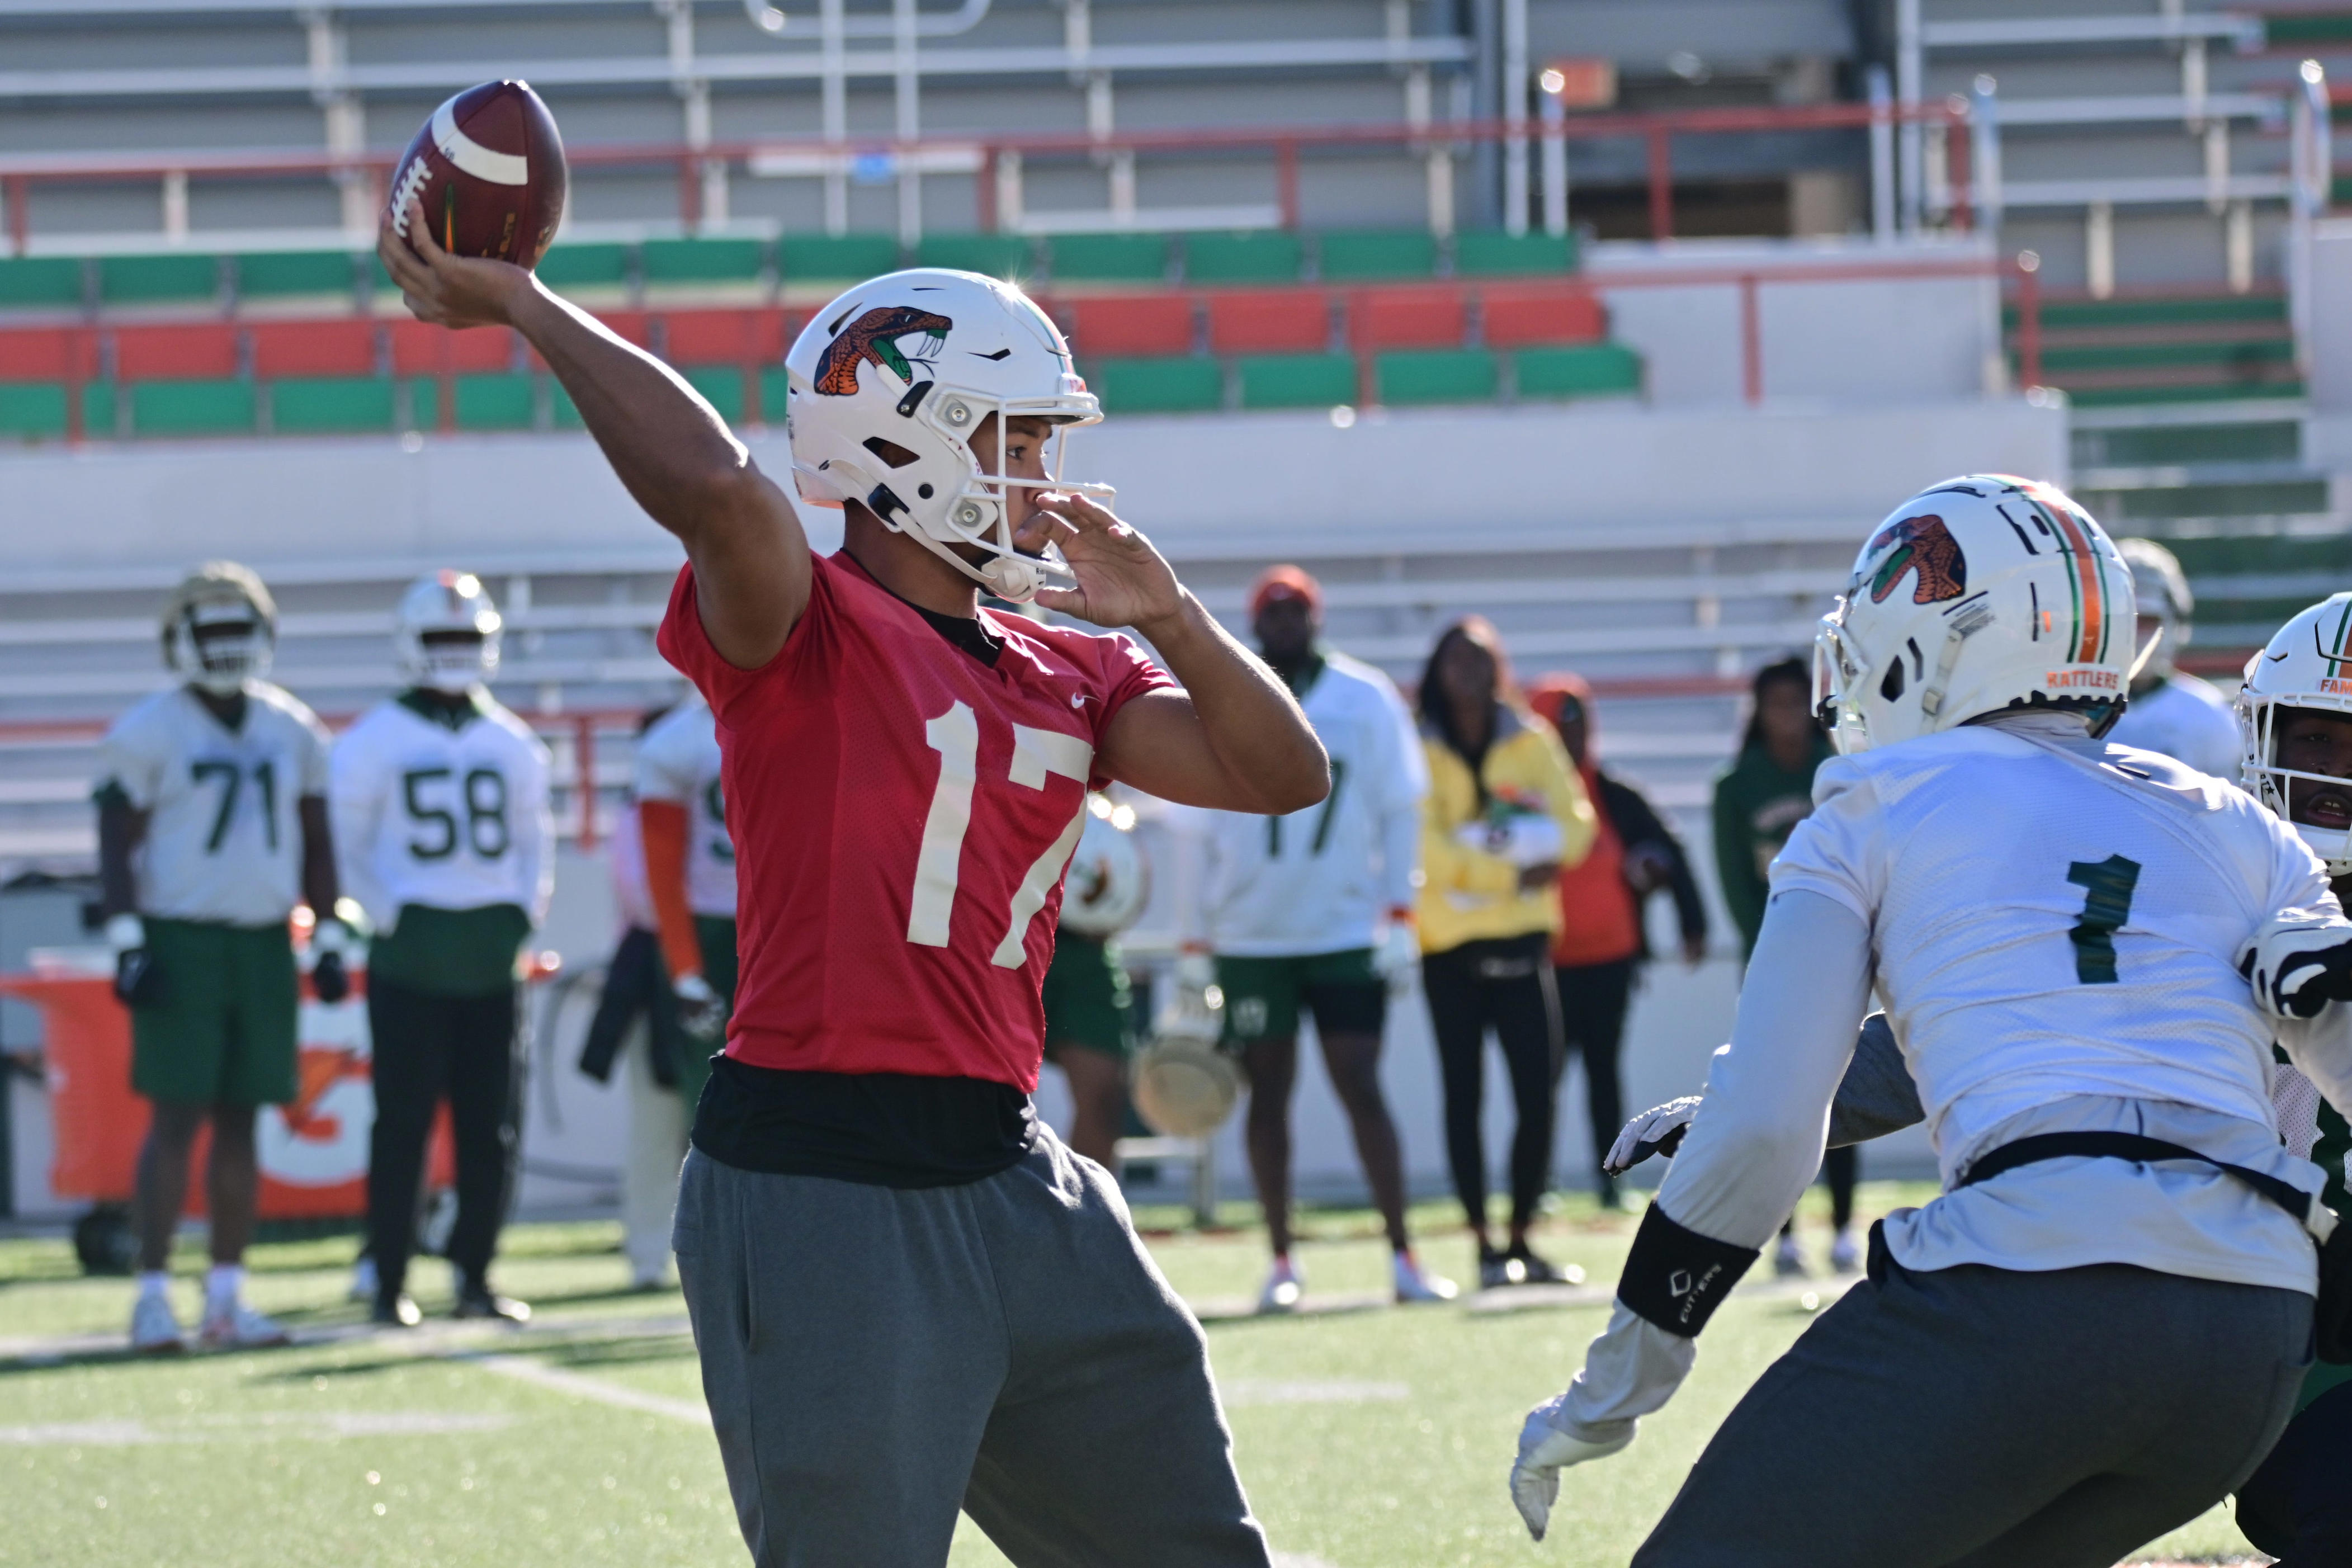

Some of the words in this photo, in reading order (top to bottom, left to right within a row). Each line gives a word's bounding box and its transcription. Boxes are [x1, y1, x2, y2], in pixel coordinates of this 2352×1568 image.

[2047, 670, 2118, 690] RATTLERS
[192, 759, 278, 855] 71
[403, 768, 508, 861] 58
[906, 699, 1095, 970] 17
[2066, 853, 2143, 984] 1
